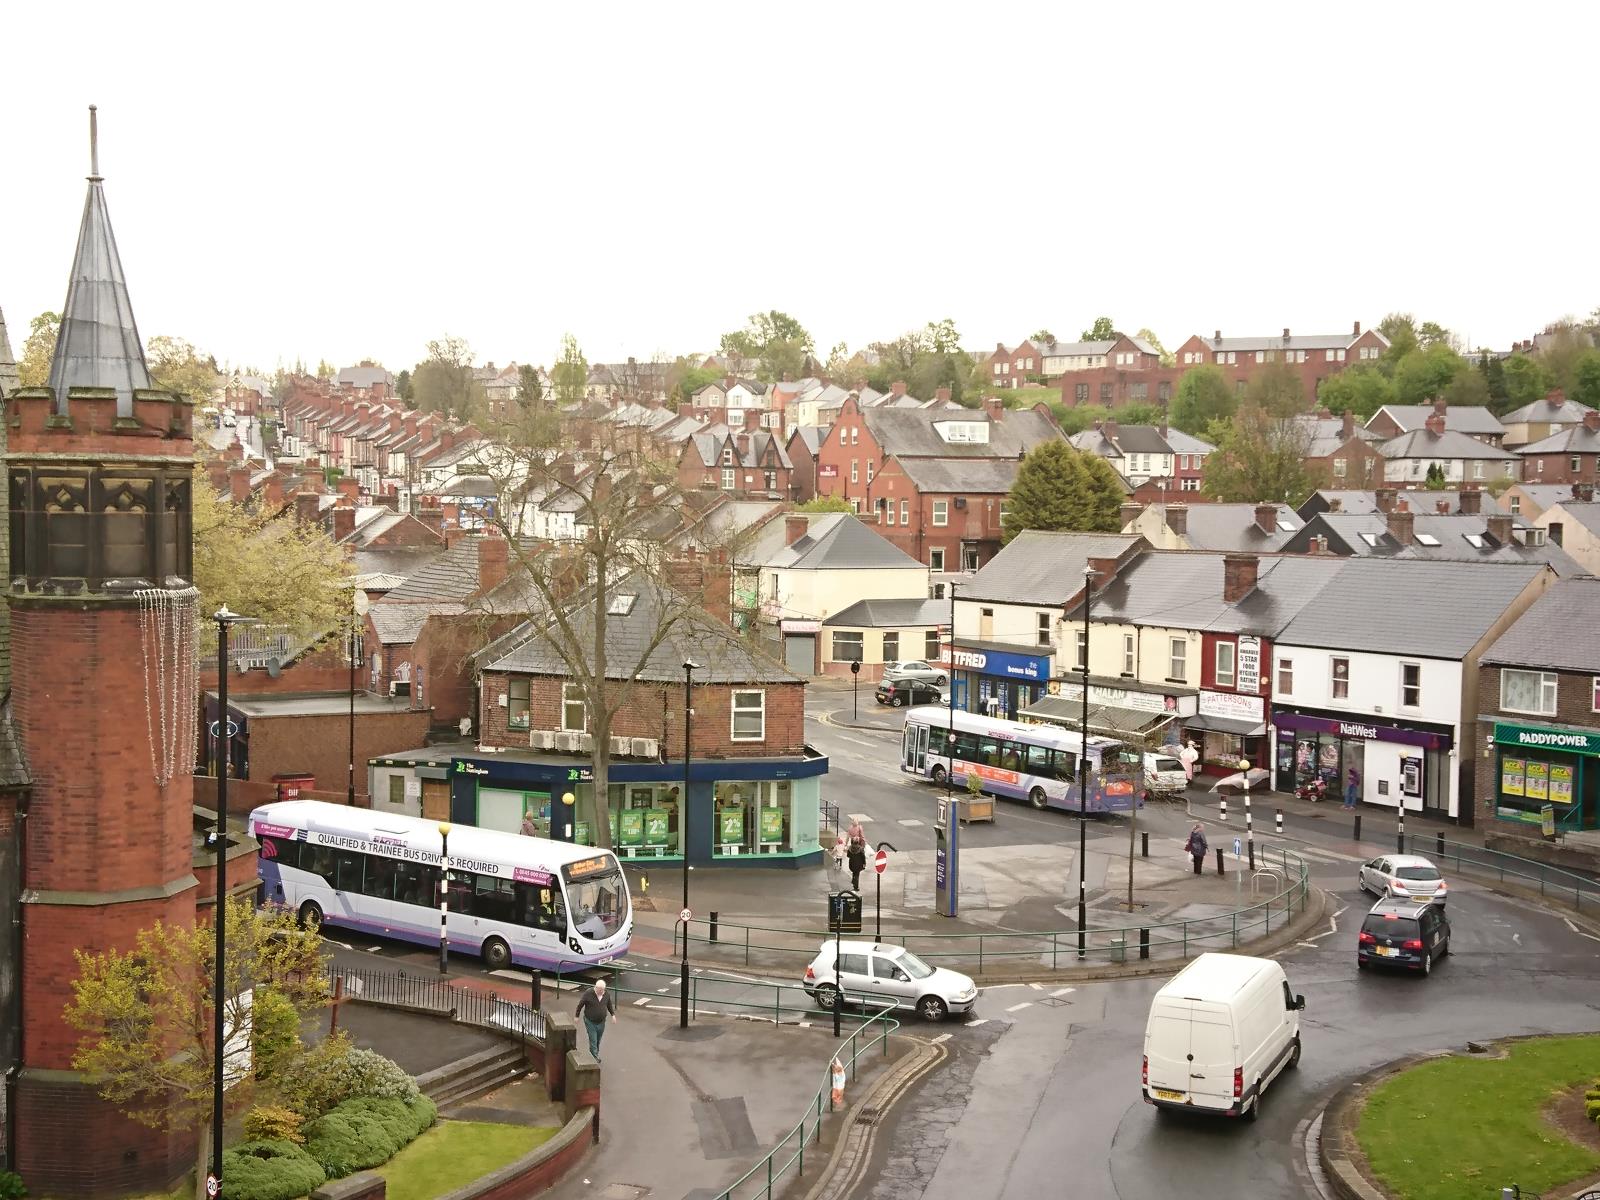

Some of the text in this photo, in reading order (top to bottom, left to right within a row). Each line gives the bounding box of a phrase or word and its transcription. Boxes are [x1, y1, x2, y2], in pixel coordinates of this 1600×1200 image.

[1007, 665, 1038, 678] bonus king
[1239, 670, 1259, 678] HYGIENE
[1207, 694, 1253, 710] PATTERSONS
[1340, 723, 1377, 739] NatWest
[1519, 732, 1588, 747] PADDYPOWER
[724, 818, 741, 833] 2%
[318, 833, 359, 850] QUALIFIED
[360, 841, 367, 851] &
[368, 842, 402, 857] TRAINEE
[403, 849, 420, 861] BUS
[421, 852, 455, 866] DRIVES
[456, 858, 499, 874] REQUIRED
[208, 1180, 217, 1191] 20
